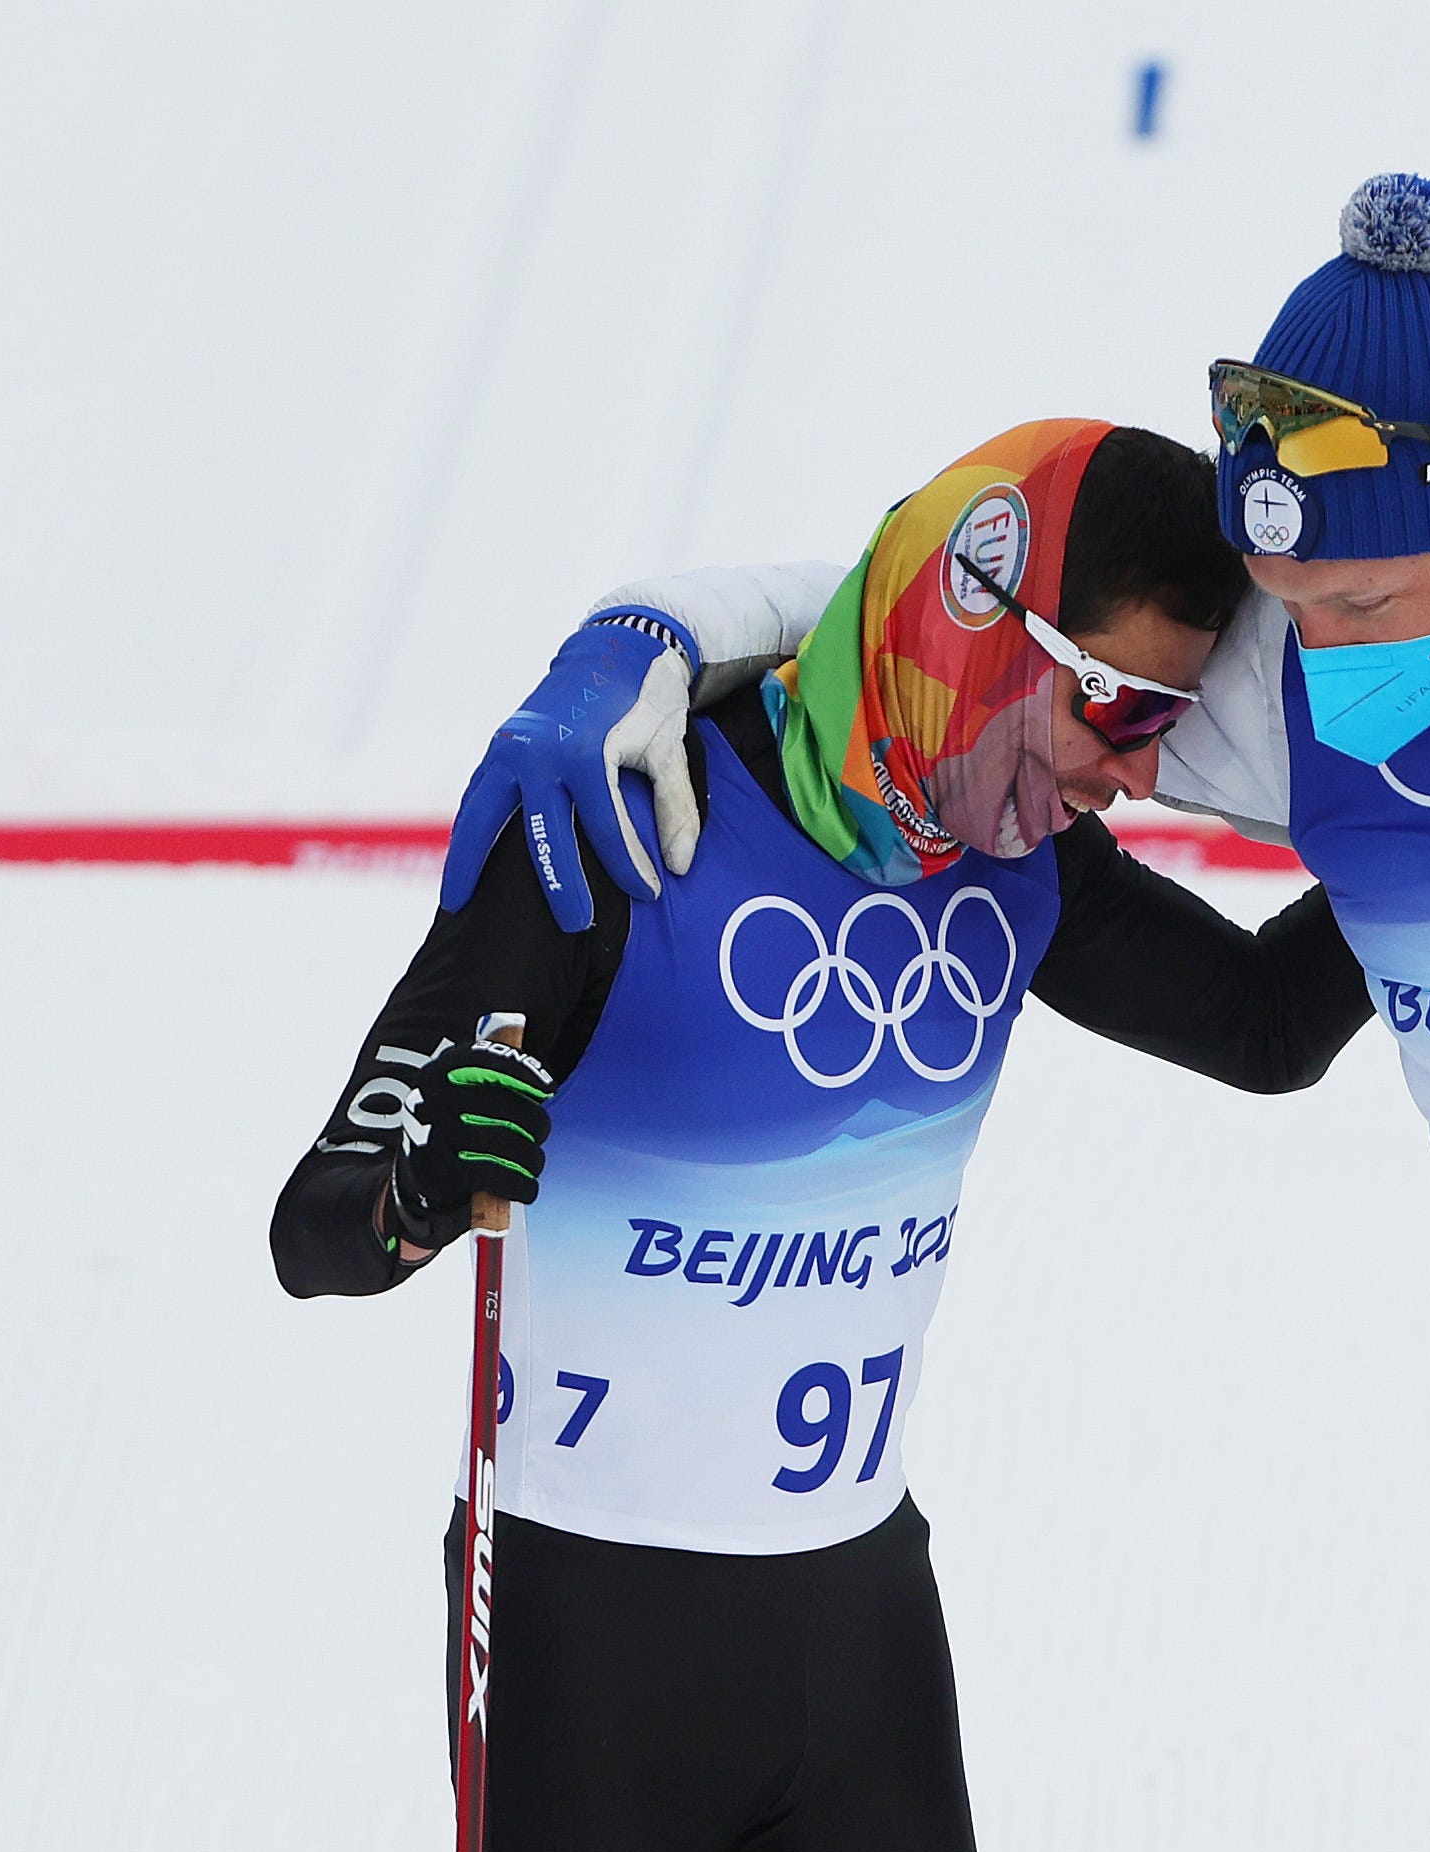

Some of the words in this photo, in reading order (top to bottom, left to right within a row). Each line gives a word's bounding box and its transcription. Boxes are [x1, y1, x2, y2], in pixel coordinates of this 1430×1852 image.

[1239, 467, 1277, 495] OLYMPIC
[1281, 473, 1307, 502] TEAM
[624, 1217, 882, 1307] BEIJING
[771, 1343, 905, 1494] 97
